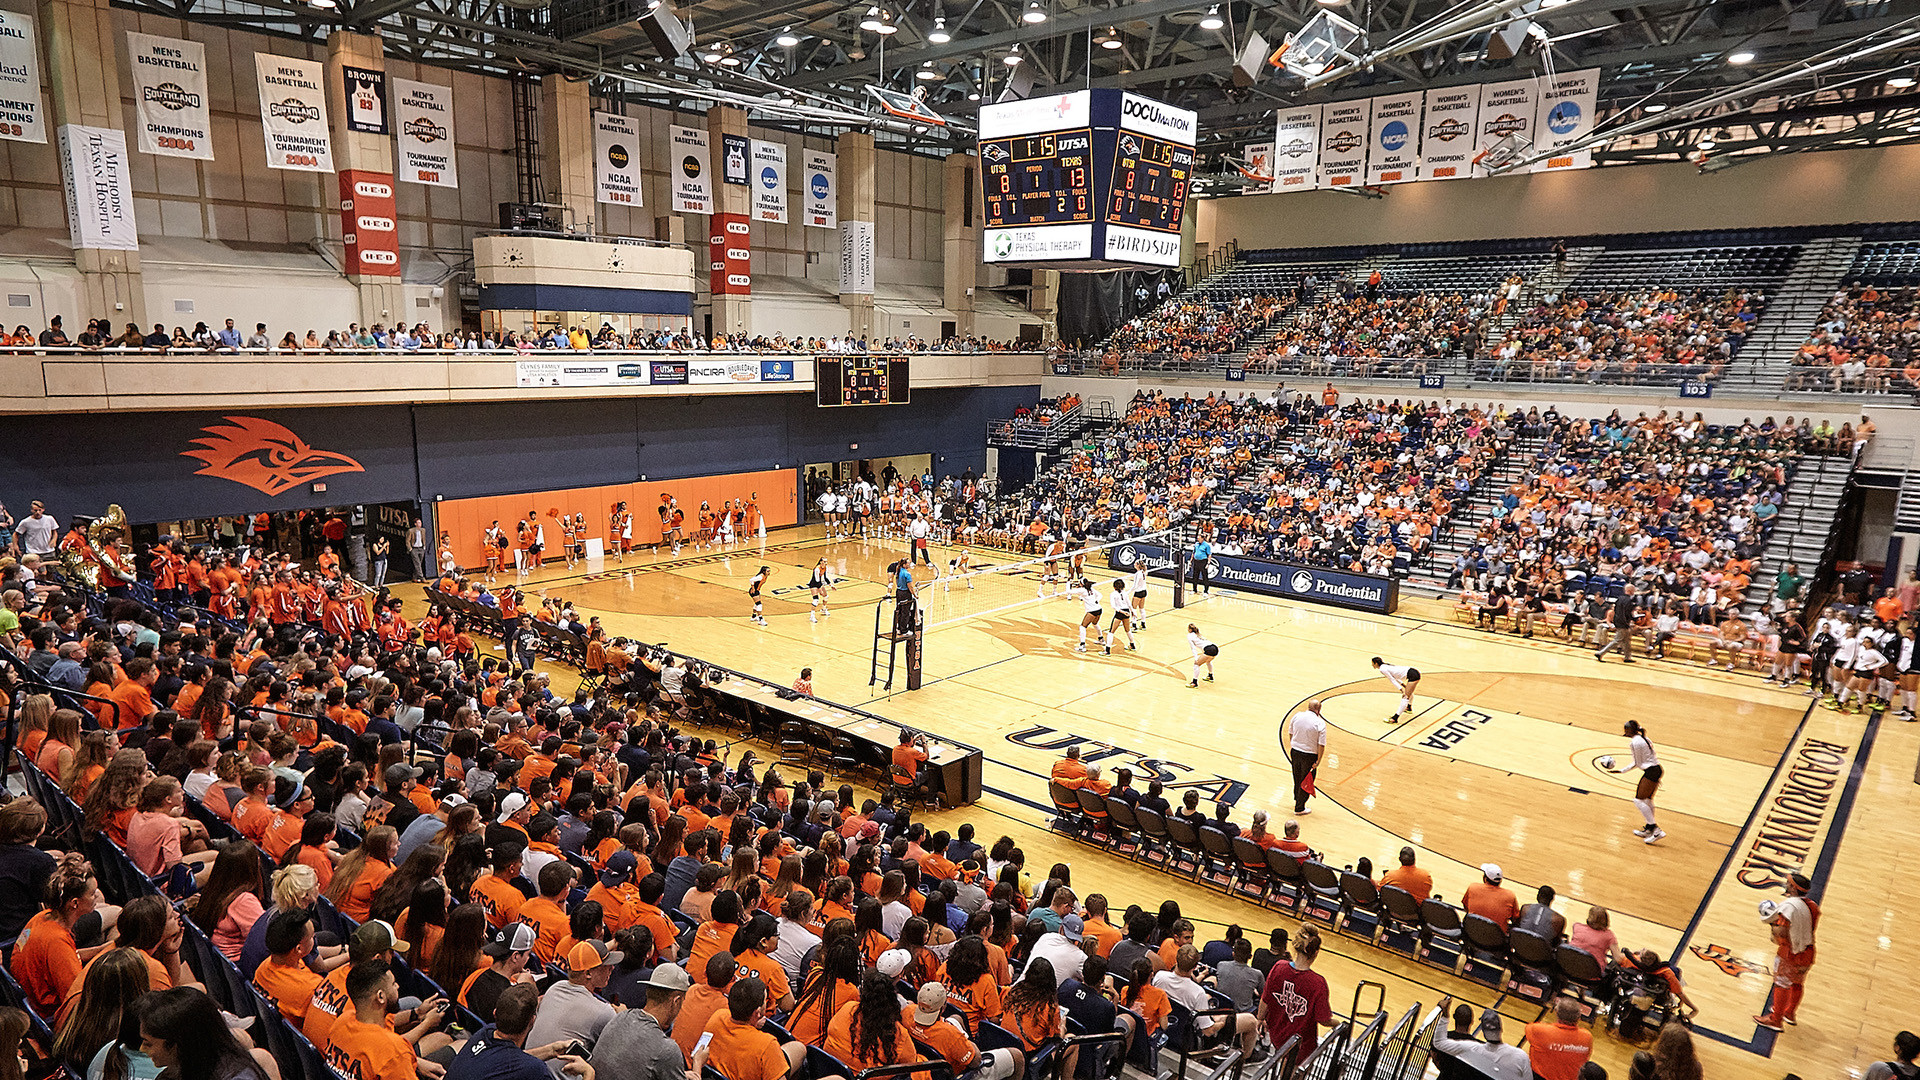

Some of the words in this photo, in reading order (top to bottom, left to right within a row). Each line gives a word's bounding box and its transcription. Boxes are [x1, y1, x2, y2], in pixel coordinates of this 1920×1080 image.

[152, 46, 182, 58] MEN'S
[138, 56, 199, 72] BASKETBALL
[278, 67, 303, 77] MEN'S
[348, 70, 381, 82] BROWN
[265, 76, 318, 90] BASKETBALL
[144, 87, 200, 108] SOUTHLAND
[412, 90, 434, 100] MEN'S
[1437, 94, 1468, 103] WOMEN'S
[1493, 88, 1525, 98] WOMEN'S
[1546, 88, 1590, 99] BASKETBALL
[402, 98, 444, 111] BASKETBALL
[1383, 101, 1412, 109] WOMEN'S
[1432, 102, 1471, 112] BASKETBALL
[1487, 97, 1529, 107] BASKETBALL
[271, 103, 319, 120] SOUTHLAND
[1333, 107, 1360, 116] WOMEN'S
[1378, 109, 1415, 118] BASKETBALL
[1286, 114, 1312, 122] WOMEN'S
[1328, 115, 1363, 124] BASKETBALL
[404, 121, 446, 140] SOUTHLAND
[600, 124, 634, 135] BASKETBALL
[1281, 121, 1315, 130] BASKETBALL
[1429, 123, 1469, 139] SOUTHLAND
[1484, 118, 1526, 135] SOUTHLAND
[147, 124, 204, 139] CHAMPIONS
[158, 136, 195, 151] 2004
[272, 134, 326, 146] TOURNAMENT
[675, 136, 706, 146] BASKETBALL
[1058, 138, 1088, 150] UTSA
[1382, 133, 1408, 144] NCAA
[276, 143, 326, 154] CHAMPIONS
[1027, 136, 1054, 156] 1:15
[406, 152, 447, 163] TOURNAMENT
[755, 153, 783, 162] BASKETBALL
[1152, 144, 1171, 163] 1:15
[1173, 152, 1191, 165] UTSA
[1428, 154, 1465, 163] CHAMPIONS
[286, 154, 317, 166] 2004
[410, 160, 445, 170] CHAMPIONS
[1061, 156, 1082, 167] TEXAS
[1324, 160, 1361, 168] TOURNAMENT
[1548, 157, 1573, 168] 2009
[808, 163, 832, 172] BASKETBALL
[991, 164, 1006, 174] UTSA
[1279, 167, 1311, 176] CHAMPIONS
[1326, 167, 1358, 175] CHAMPIONS
[1372, 162, 1412, 170] TOURNAMENT
[608, 173, 631, 184] NCAA
[1071, 168, 1084, 186] 13
[1126, 171, 1134, 190] 8
[105, 151, 122, 221] METHODIST
[601, 183, 638, 193] TOURNAMENT
[683, 183, 702, 193] NCAA
[1001, 175, 1009, 193] 8
[1173, 182, 1184, 199] 13
[677, 192, 709, 201] TOURNAMENT
[762, 194, 779, 203] NCAA
[96, 182, 111, 236] HOSPITAL
[756, 203, 785, 211] TOURNAMENT
[993, 202, 1000, 216] 0
[1058, 198, 1065, 212] 2
[1078, 196, 1085, 211] 0
[1115, 198, 1122, 212] 0
[808, 208, 833, 216] TOURNAMENT
[1161, 206, 1167, 219] 2
[1173, 208, 1180, 221] 0
[1016, 232, 1035, 241] TEXAS
[1016, 242, 1047, 252] PHYSICAL
[1051, 241, 1082, 251] THERAPY
[1108, 234, 1177, 256] #BIRDSUP
[690, 368, 725, 376] ANCIRA
[879, 376, 886, 386] 13
[1687, 387, 1706, 395] 103
[380, 506, 410, 528] UTSA
[1222, 568, 1281, 586] Prudential
[1316, 579, 1382, 601] Prudential
[1005, 724, 1250, 808] UTSA
[1737, 738, 1850, 893] ROADRUNNERS
[1075, 990, 1087, 1000] 20
